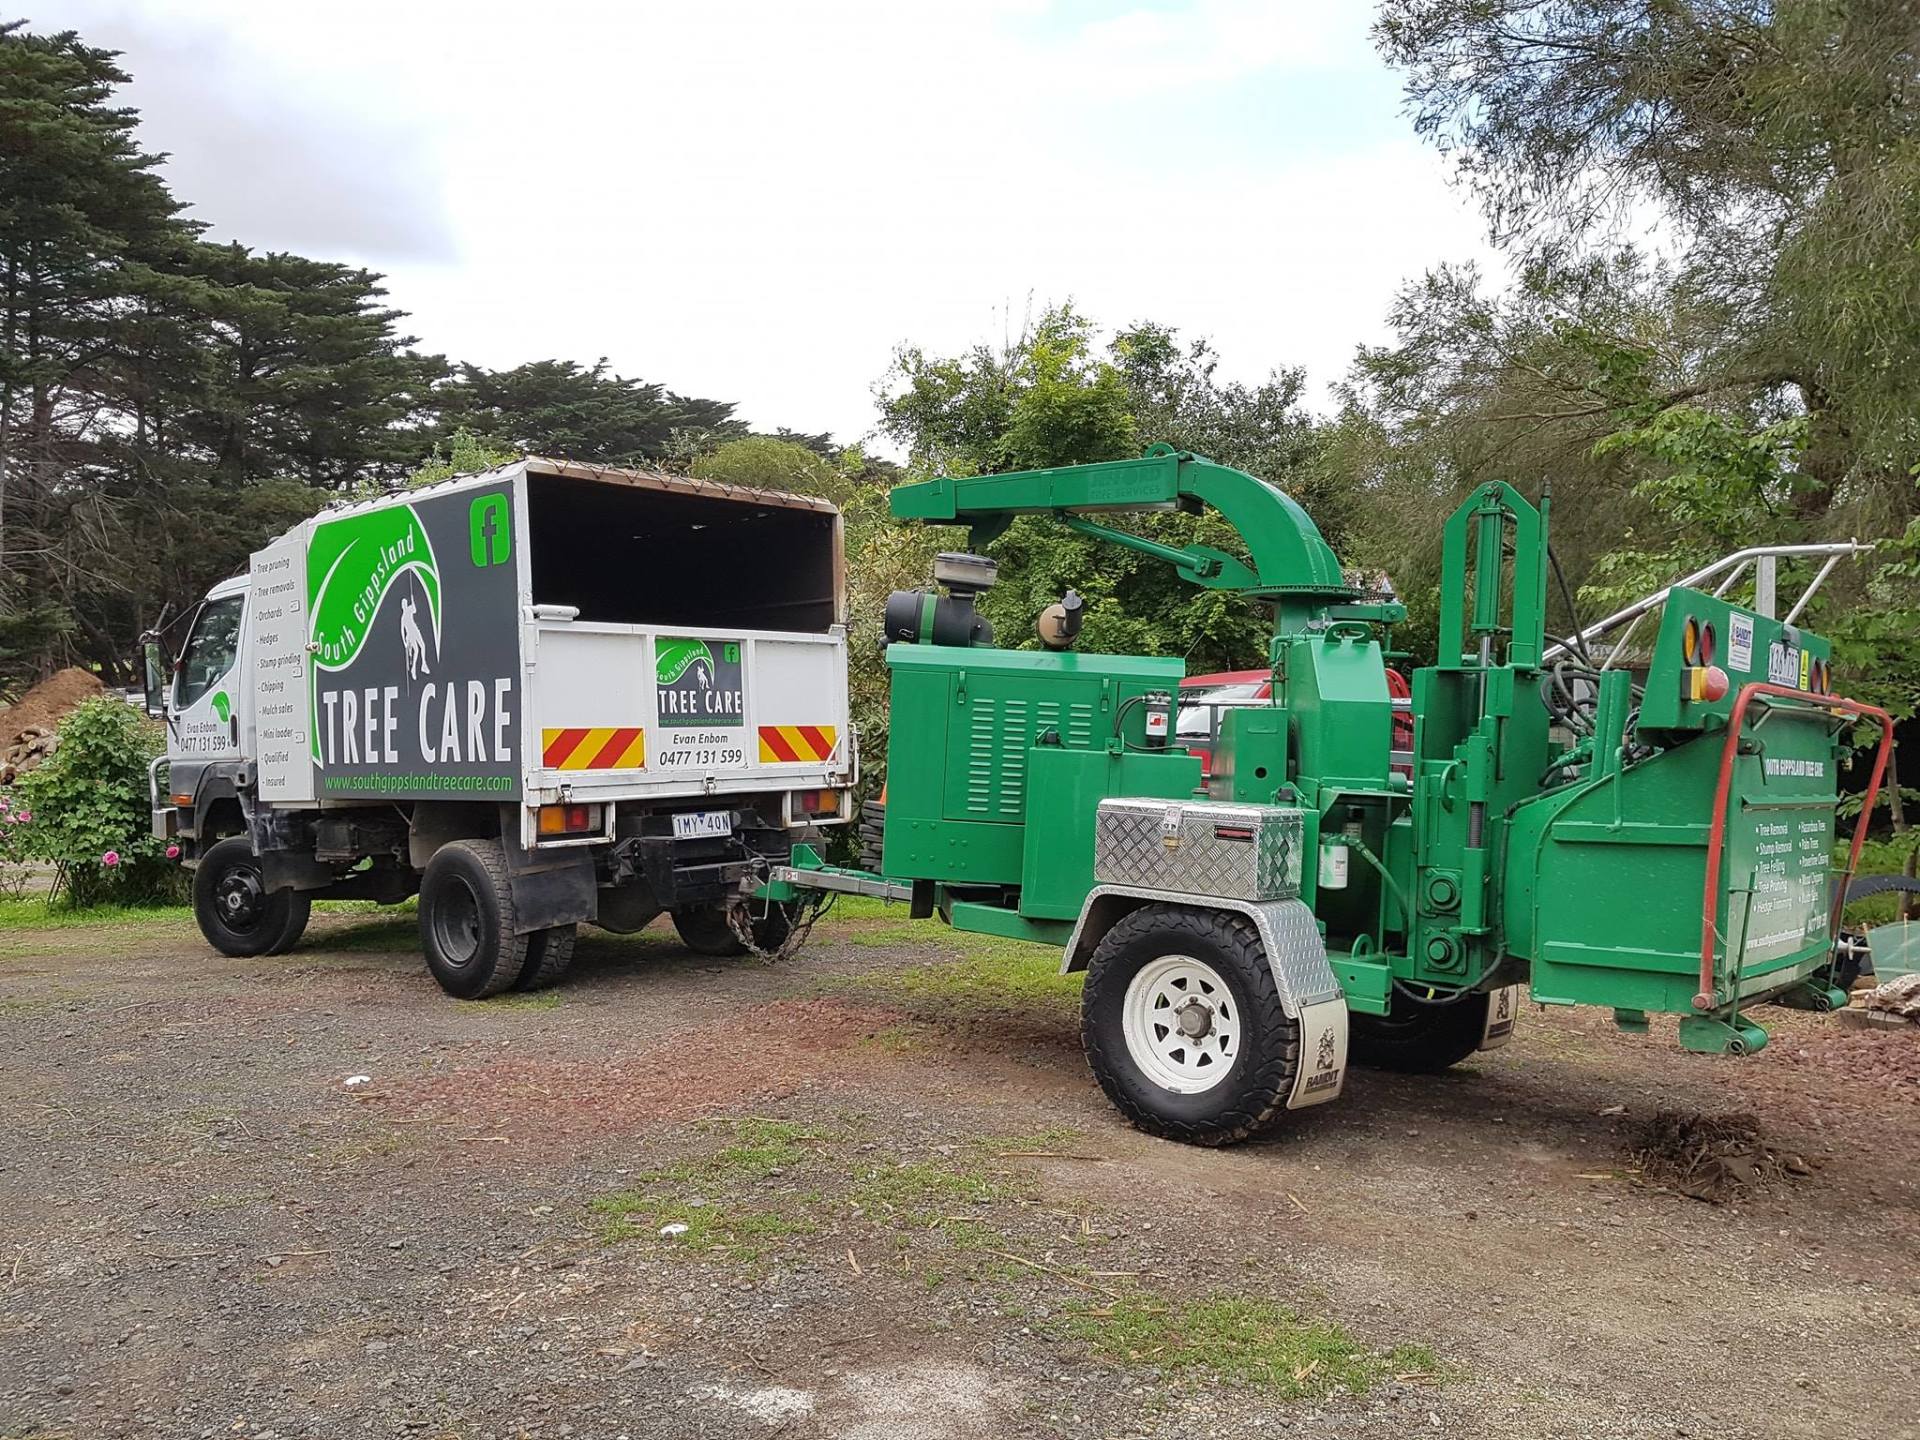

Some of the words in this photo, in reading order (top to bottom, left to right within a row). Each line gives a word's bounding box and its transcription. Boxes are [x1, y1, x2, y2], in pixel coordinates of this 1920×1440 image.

[257, 563, 269, 574] Tree
[268, 557, 290, 574] pruning
[258, 586, 269, 597] Tree
[269, 579, 295, 594] removals
[317, 624, 356, 661] South
[353, 523, 414, 624] Gippsland
[258, 607, 283, 621] Orchards
[259, 633, 279, 646] Hedges
[260, 658, 277, 670] Stump
[277, 652, 301, 668] grinding
[261, 680, 284, 695] Chipping
[262, 703, 278, 716] Mulch
[278, 702, 293, 714] sales
[658, 690, 697, 714] TREE
[705, 690, 742, 714] CARE
[186, 722, 200, 734] Evan
[200, 722, 218, 733] Enbom
[323, 686, 398, 764] TREE
[418, 677, 512, 763] CARE
[263, 728, 275, 739] Mini
[275, 727, 294, 738] loader
[673, 733, 696, 745] Evan
[698, 732, 728, 745] Enbom
[180, 738, 197, 752] 0477
[198, 737, 212, 751] 131
[212, 736, 226, 750] 599
[264, 751, 289, 765] Qualified
[659, 751, 692, 766] 0477
[695, 750, 718, 764] 131
[720, 749, 743, 763] 599
[266, 775, 286, 787] Insured
[324, 772, 513, 793] www.southgippslandtreecare.com
[677, 817, 698, 834] 1MY
